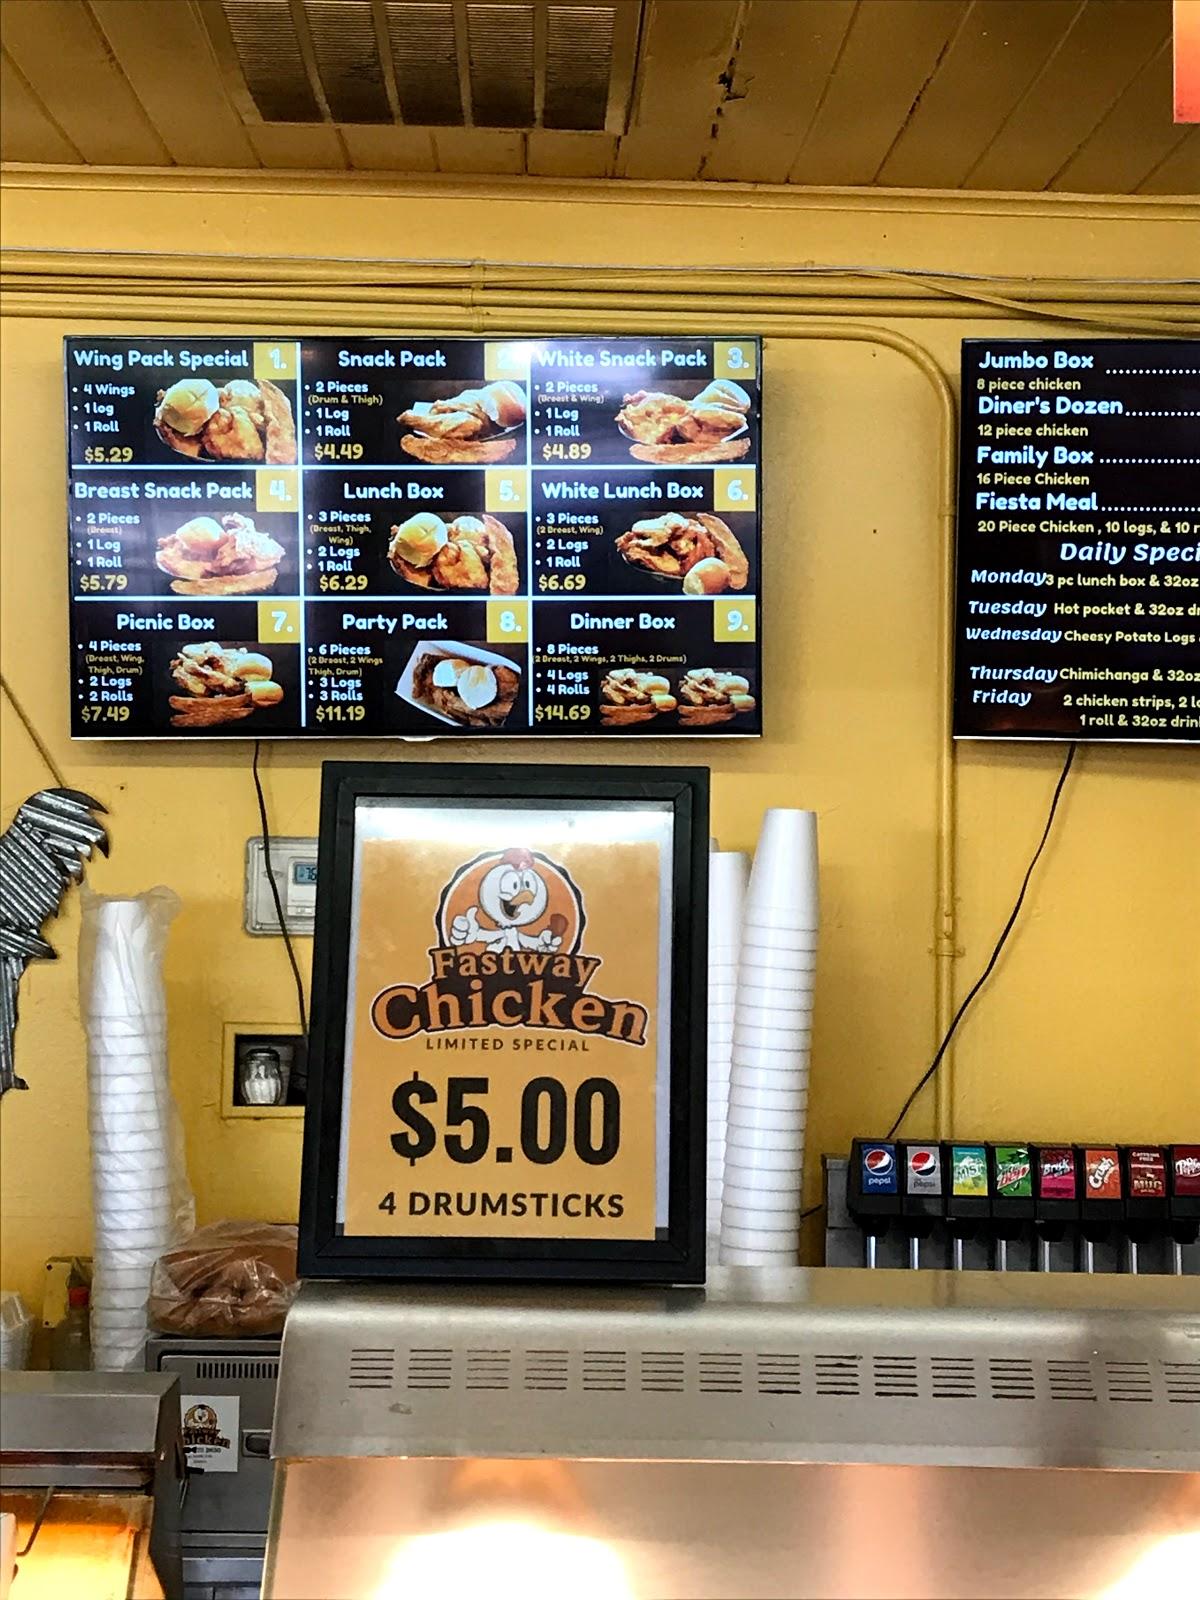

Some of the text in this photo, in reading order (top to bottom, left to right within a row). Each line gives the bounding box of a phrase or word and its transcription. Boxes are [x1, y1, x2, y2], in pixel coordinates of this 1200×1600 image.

[74, 350, 248, 371] Wing Pack Special
[269, 348, 287, 369] 1.
[338, 350, 446, 367] Snack Pack
[537, 351, 594, 367] White
[600, 350, 656, 367] Snack
[662, 350, 707, 367] Pack
[728, 347, 749, 368] 3.
[979, 351, 1093, 368] Jumbo Box
[83, 384, 135, 395] 4 Wings
[328, 382, 368, 393] Pieces
[558, 382, 598, 393] Pieces
[977, 378, 1081, 393] 8 piece chicken
[308, 395, 383, 406] (Drum Thigh)
[978, 396, 1123, 414] Diner's Dozen
[93, 402, 114, 416] log
[325, 408, 349, 421] Log
[555, 408, 579, 420] Log
[94, 421, 119, 432] Roll
[325, 425, 350, 436] Roll
[555, 425, 580, 436] Roll
[978, 424, 1088, 439] 12 piece chicken
[85, 447, 133, 464] $5.29
[315, 443, 363, 460] $4.49
[543, 443, 592, 461] $4.89
[977, 445, 1093, 469] Family Box
[977, 472, 1089, 485] 16 Piece Chicken
[74, 482, 252, 499] Breast Snack Pack
[270, 480, 292, 501] 4.
[344, 483, 444, 499] Lunch Box
[500, 480, 520, 500] 5.
[542, 482, 704, 498] White Lunch Box
[728, 480, 748, 500] 6.
[976, 492, 1098, 510] Fiesta Meal
[99, 513, 140, 524] Pieces
[331, 511, 371, 522] Pieces
[558, 513, 598, 524] Pieces
[978, 521, 995, 532] 20
[999, 521, 1036, 532] Piece
[1039, 521, 1094, 533] Chicken
[1105, 522, 1120, 533] 10
[1124, 521, 1156, 536] logs,
[1160, 521, 1171, 533] &
[1175, 522, 1190, 533] 10
[97, 539, 120, 552] Log
[330, 546, 360, 559] Logs
[558, 539, 588, 552] Logs
[1060, 541, 1126, 564] Daily
[97, 556, 122, 568] Roll
[327, 560, 352, 571] Roll
[556, 556, 580, 568] Roll
[80, 574, 127, 591] $5.79
[320, 575, 368, 591] $6.29
[539, 574, 586, 591] $6.69
[971, 569, 1199, 588] Monday pc lunch box & 32oz
[969, 600, 1184, 617] Tuesday Hot pocket & 32oz
[117, 614, 215, 630] Picnic Box
[272, 611, 293, 632] 7.
[343, 613, 448, 634] Party Pack
[500, 611, 522, 632] 8.
[571, 613, 676, 629] Dinner Box
[727, 610, 748, 632] 9.
[966, 627, 1062, 643] Wednesday
[1064, 631, 1112, 644] Cheesy
[1115, 631, 1161, 642] Potato
[1165, 632, 1195, 645] Logs
[89, 641, 142, 651] 4 Pieces
[319, 644, 371, 655] 6 Pieces
[558, 643, 598, 655] Pieces
[657, 655, 687, 663] Drums)
[90, 676, 132, 688] 2 Logs
[320, 677, 361, 689] 3 Logs
[547, 670, 588, 682] 4 Logs
[970, 666, 1200, 684] Thursday Chimichanga & 32oz
[90, 691, 133, 702] 2 Rolls
[320, 690, 363, 701] 3 Rolls
[547, 684, 590, 695] 4 Rolls
[973, 689, 1031, 706] Friday
[1064, 695, 1072, 706] 2
[1076, 694, 1128, 707] chicken
[1132, 695, 1175, 710] strips,
[1179, 696, 1187, 707] 2
[82, 706, 130, 723] $7.49
[316, 706, 365, 722] $11.19
[535, 705, 590, 721] $14.69
[1089, 714, 1113, 726] roll
[1118, 714, 1128, 726] &
[1132, 715, 1167, 727] 32oz
[430, 948, 600, 987] Fastway
[372, 979, 647, 1044] Chicken
[427, 1038, 589, 1052] LIMITED SPECIAL
[390, 1071, 620, 1166] $5.00
[868, 1177, 891, 1185] pepsi
[379, 1192, 624, 1218] 4 DRUMSTICKS
